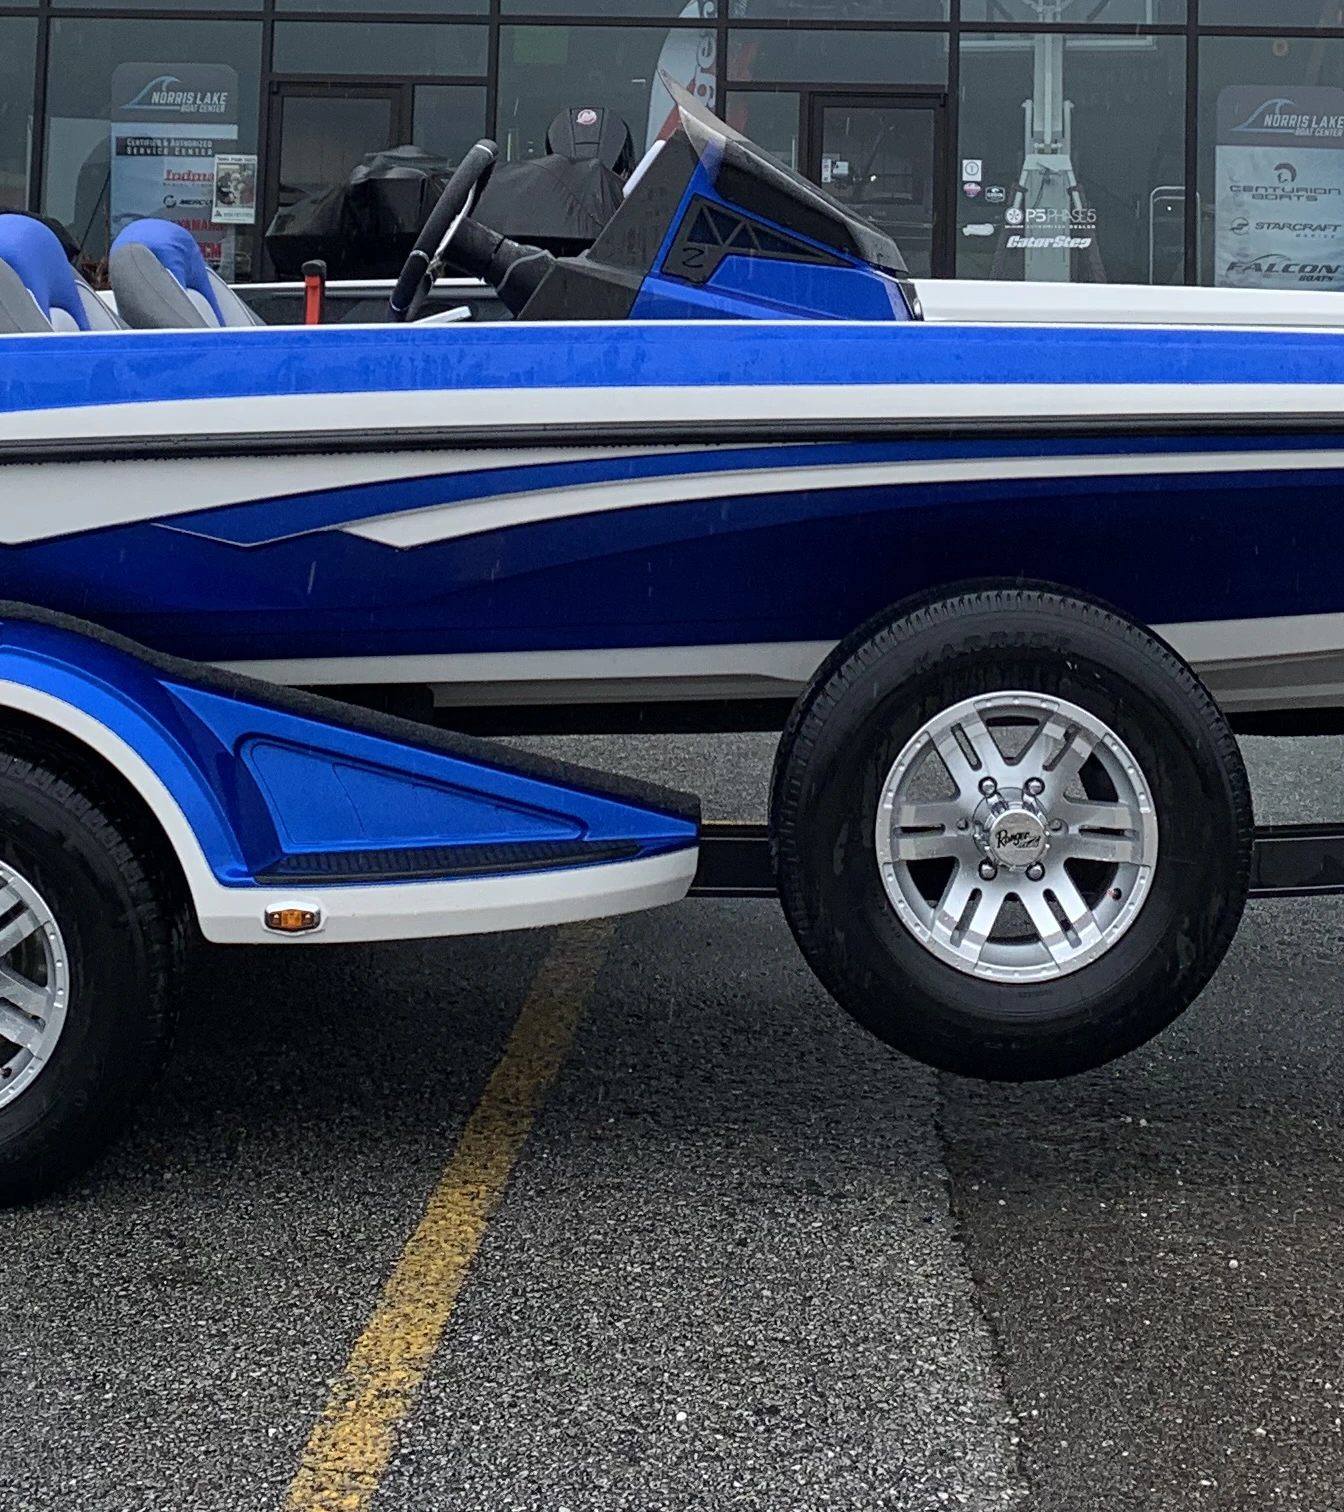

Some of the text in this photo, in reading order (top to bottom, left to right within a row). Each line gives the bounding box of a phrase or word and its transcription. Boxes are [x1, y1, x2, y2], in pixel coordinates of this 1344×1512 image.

[151, 91, 229, 106] NORRIS LAKE
[180, 104, 226, 113] BOAT CENTER
[1263, 113, 1310, 128] NORRIS
[1294, 128, 1343, 137] BOAT CENTER
[126, 146, 213, 156] SERVICE CENTER
[164, 169, 214, 182] Indma
[1254, 221, 1342, 232] STARCRAFT
[1006, 235, 1092, 249] GatorStep
[1225, 261, 1342, 274] FALCON
[994, 829, 1030, 849] Ranger
